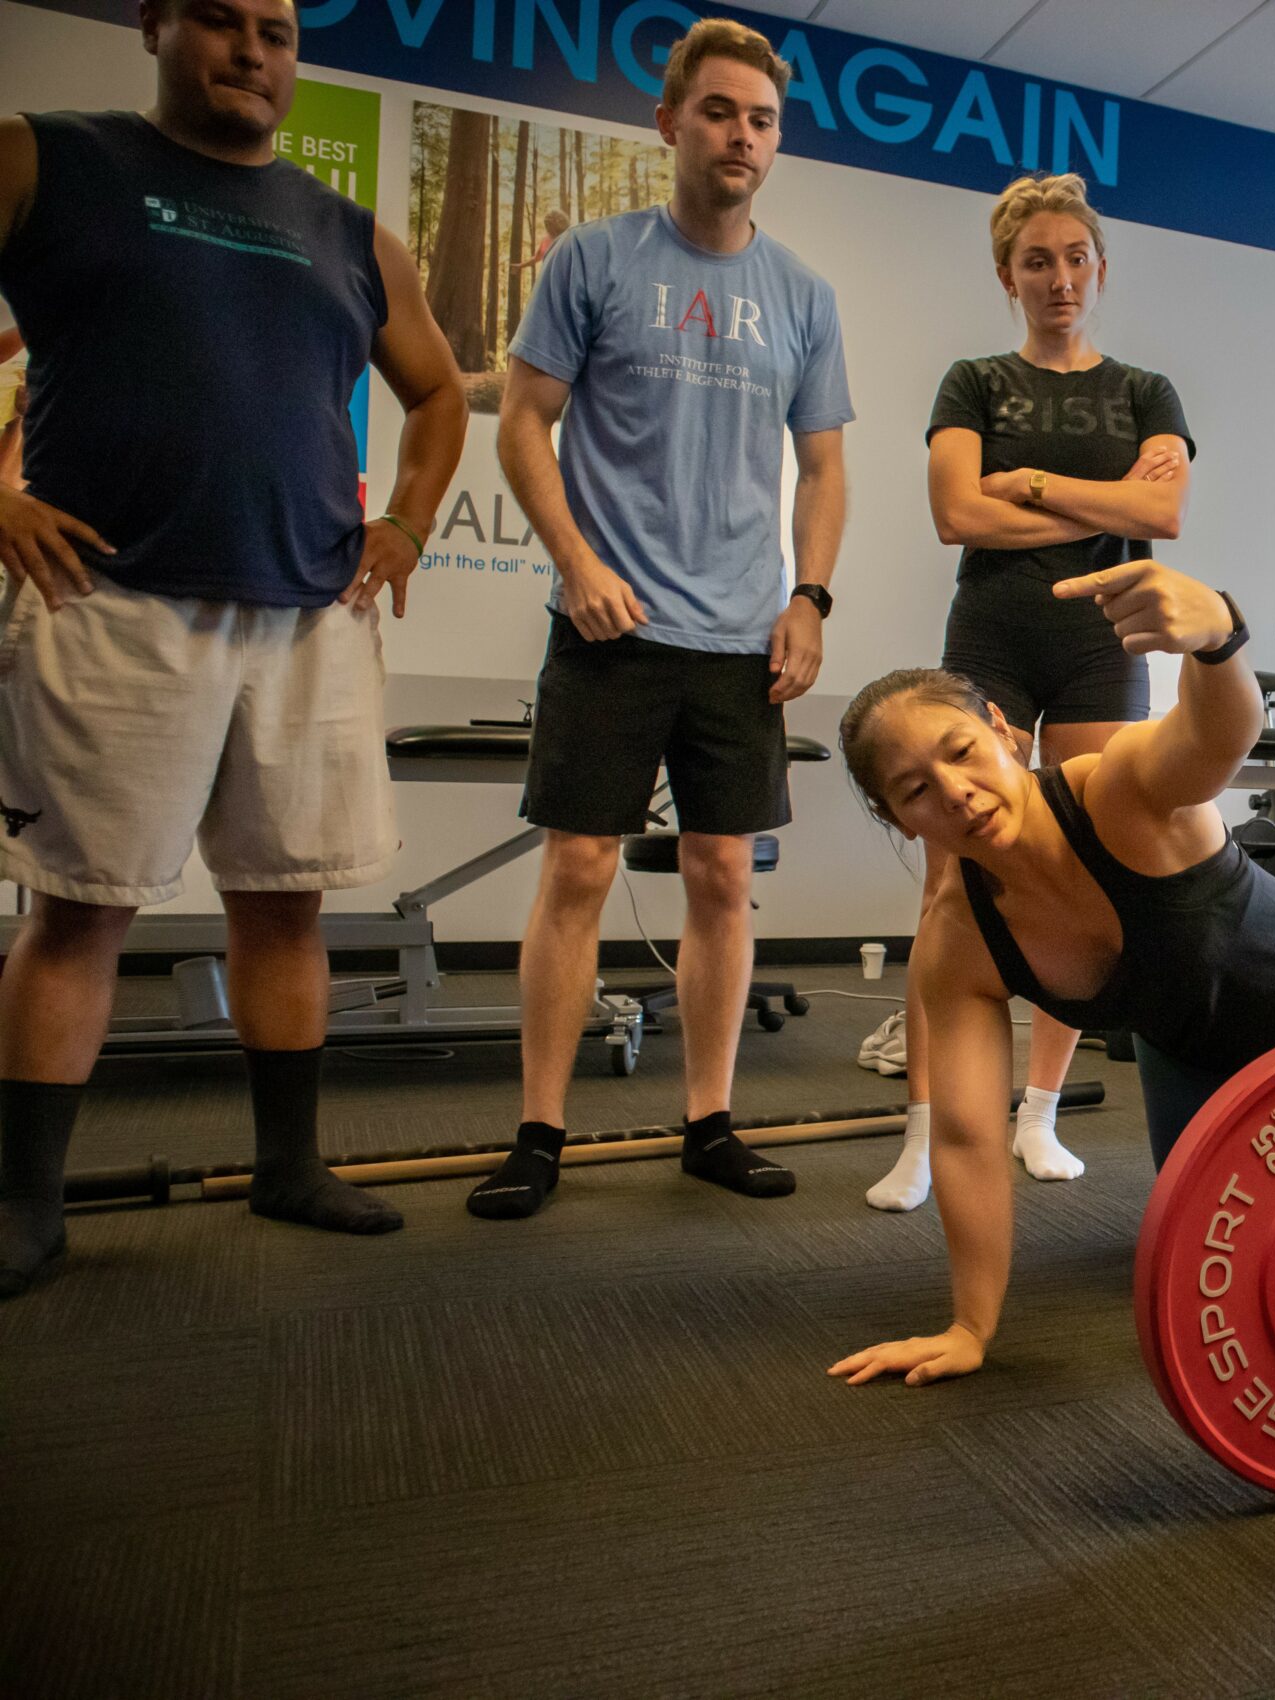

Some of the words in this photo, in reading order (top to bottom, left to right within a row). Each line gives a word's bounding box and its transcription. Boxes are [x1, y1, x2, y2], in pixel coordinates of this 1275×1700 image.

[777, 29, 1121, 187] AGAIN
[302, 136, 358, 163] BEST
[648, 283, 768, 348] IAR
[627, 365, 683, 380] ATHLETE
[685, 372, 772, 398] REGENERATION
[660, 353, 722, 373] INSTITUTE
[725, 364, 750, 378] FOR
[995, 396, 1137, 441] RISE
[430, 490, 538, 547] AL
[419, 552, 450, 570] ght
[456, 555, 486, 571] the
[1199, 1173, 1256, 1383] SPORT
